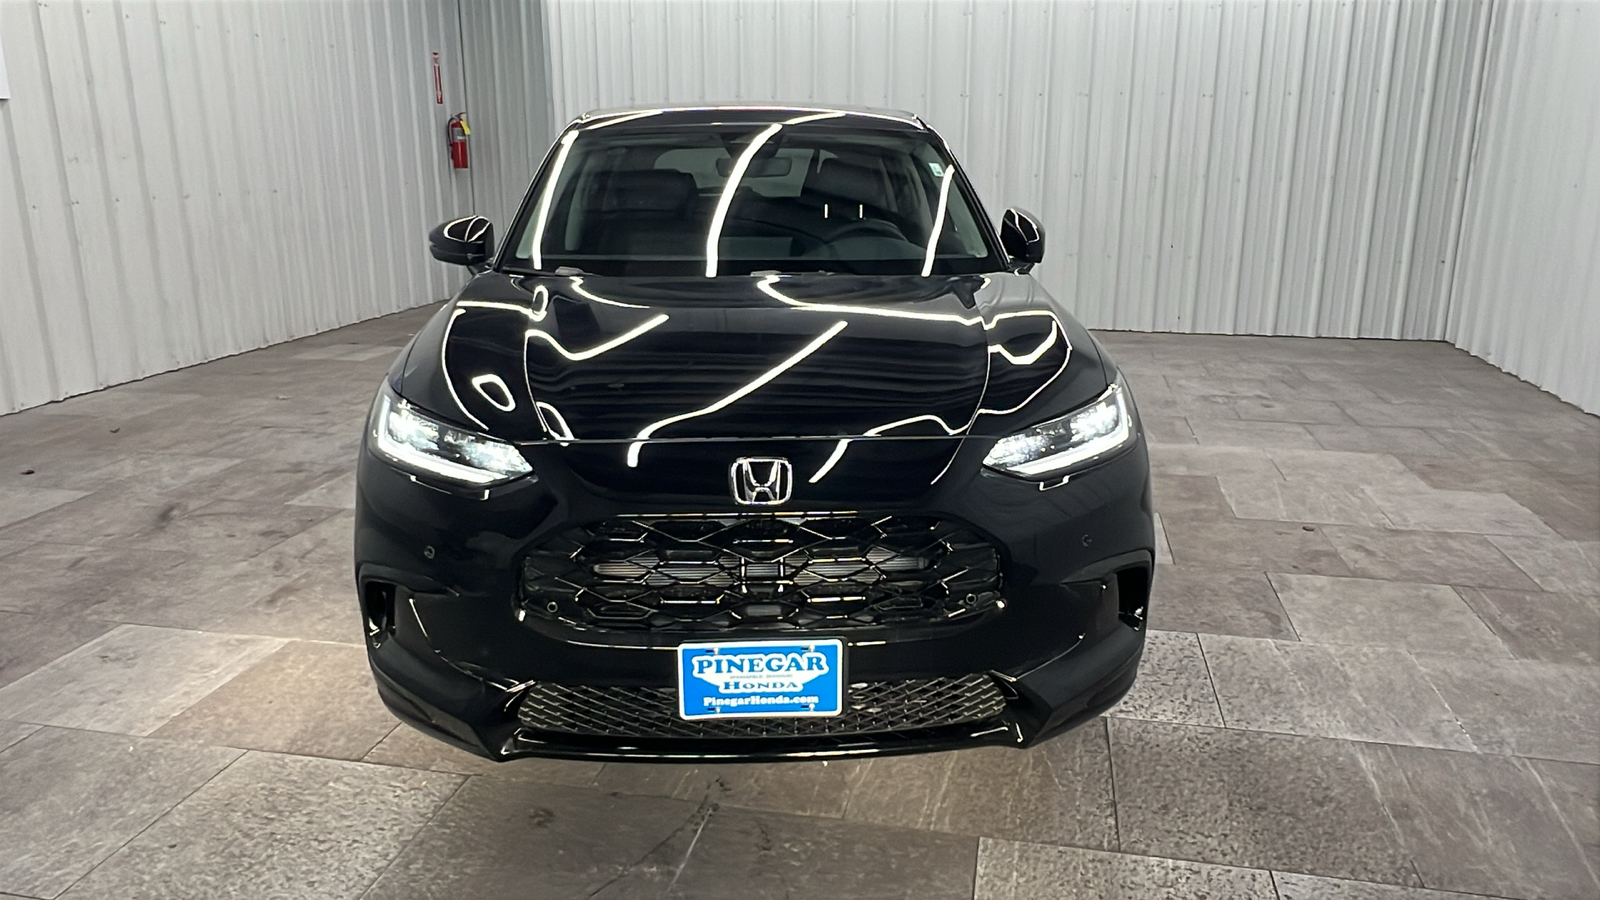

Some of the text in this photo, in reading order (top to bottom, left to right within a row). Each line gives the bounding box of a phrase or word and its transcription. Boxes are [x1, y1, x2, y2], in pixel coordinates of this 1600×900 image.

[697, 656, 825, 674] PINEGAR
[723, 681, 799, 690] HONDA
[703, 695, 819, 707] PinegarHonda.com
